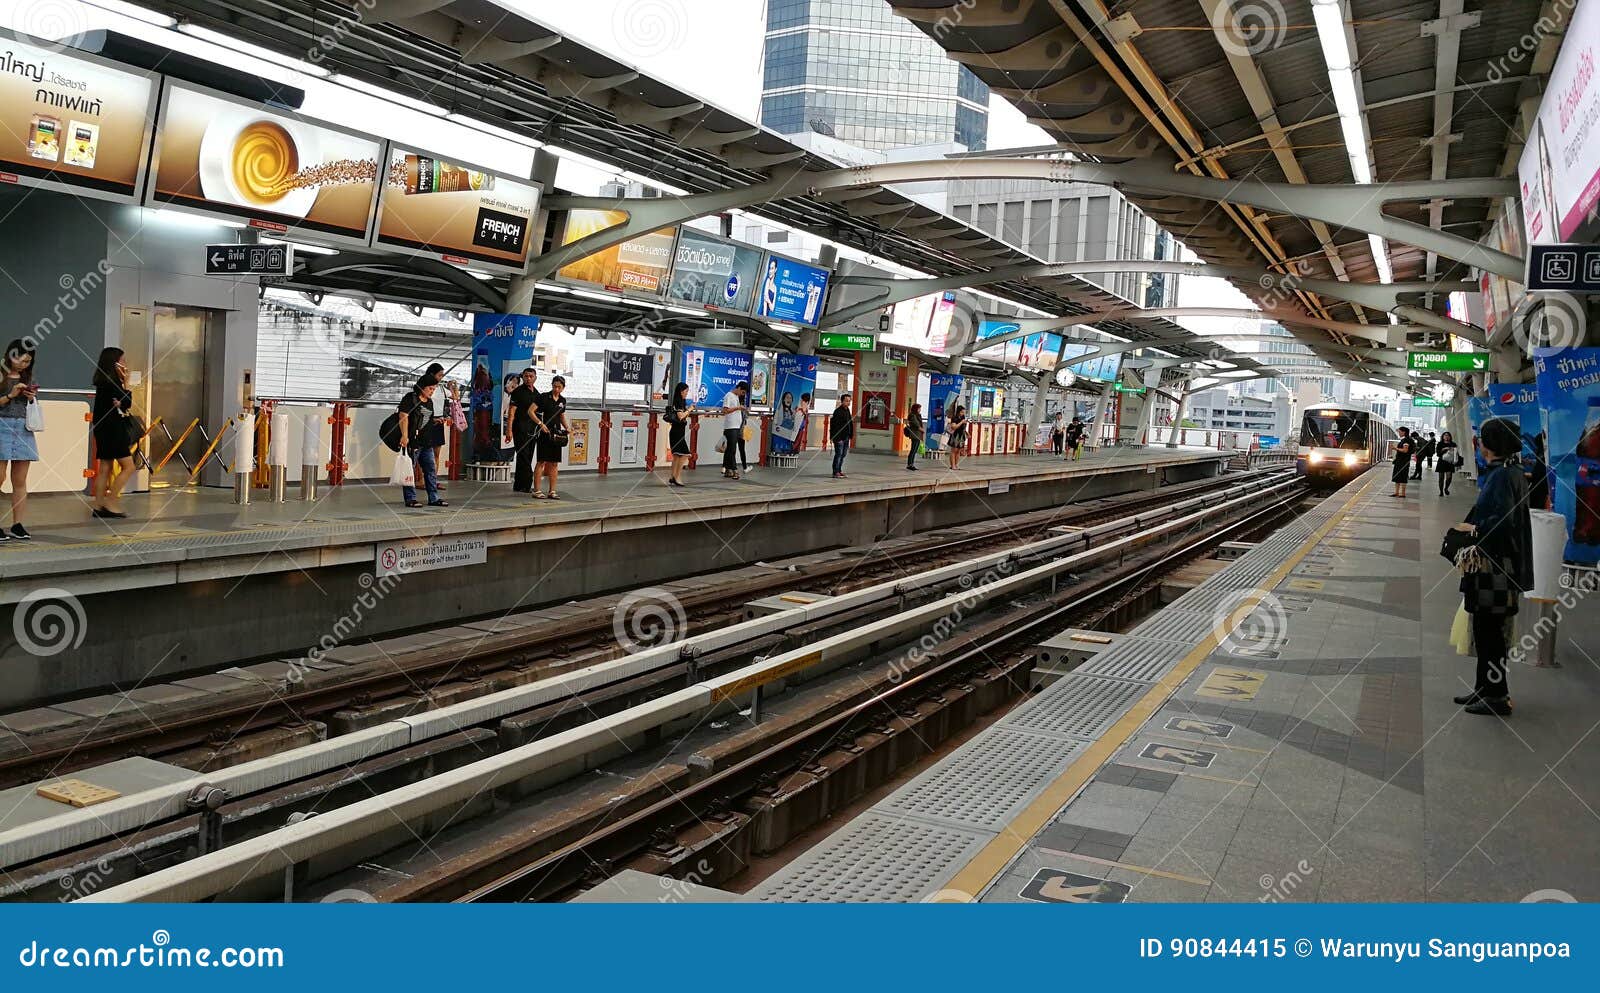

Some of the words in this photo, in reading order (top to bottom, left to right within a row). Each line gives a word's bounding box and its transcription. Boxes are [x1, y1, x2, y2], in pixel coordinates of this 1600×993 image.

[482, 217, 521, 237] FRENCH
[1413, 353, 1447, 362] ทางออก
[422, 558, 435, 566] Keep
